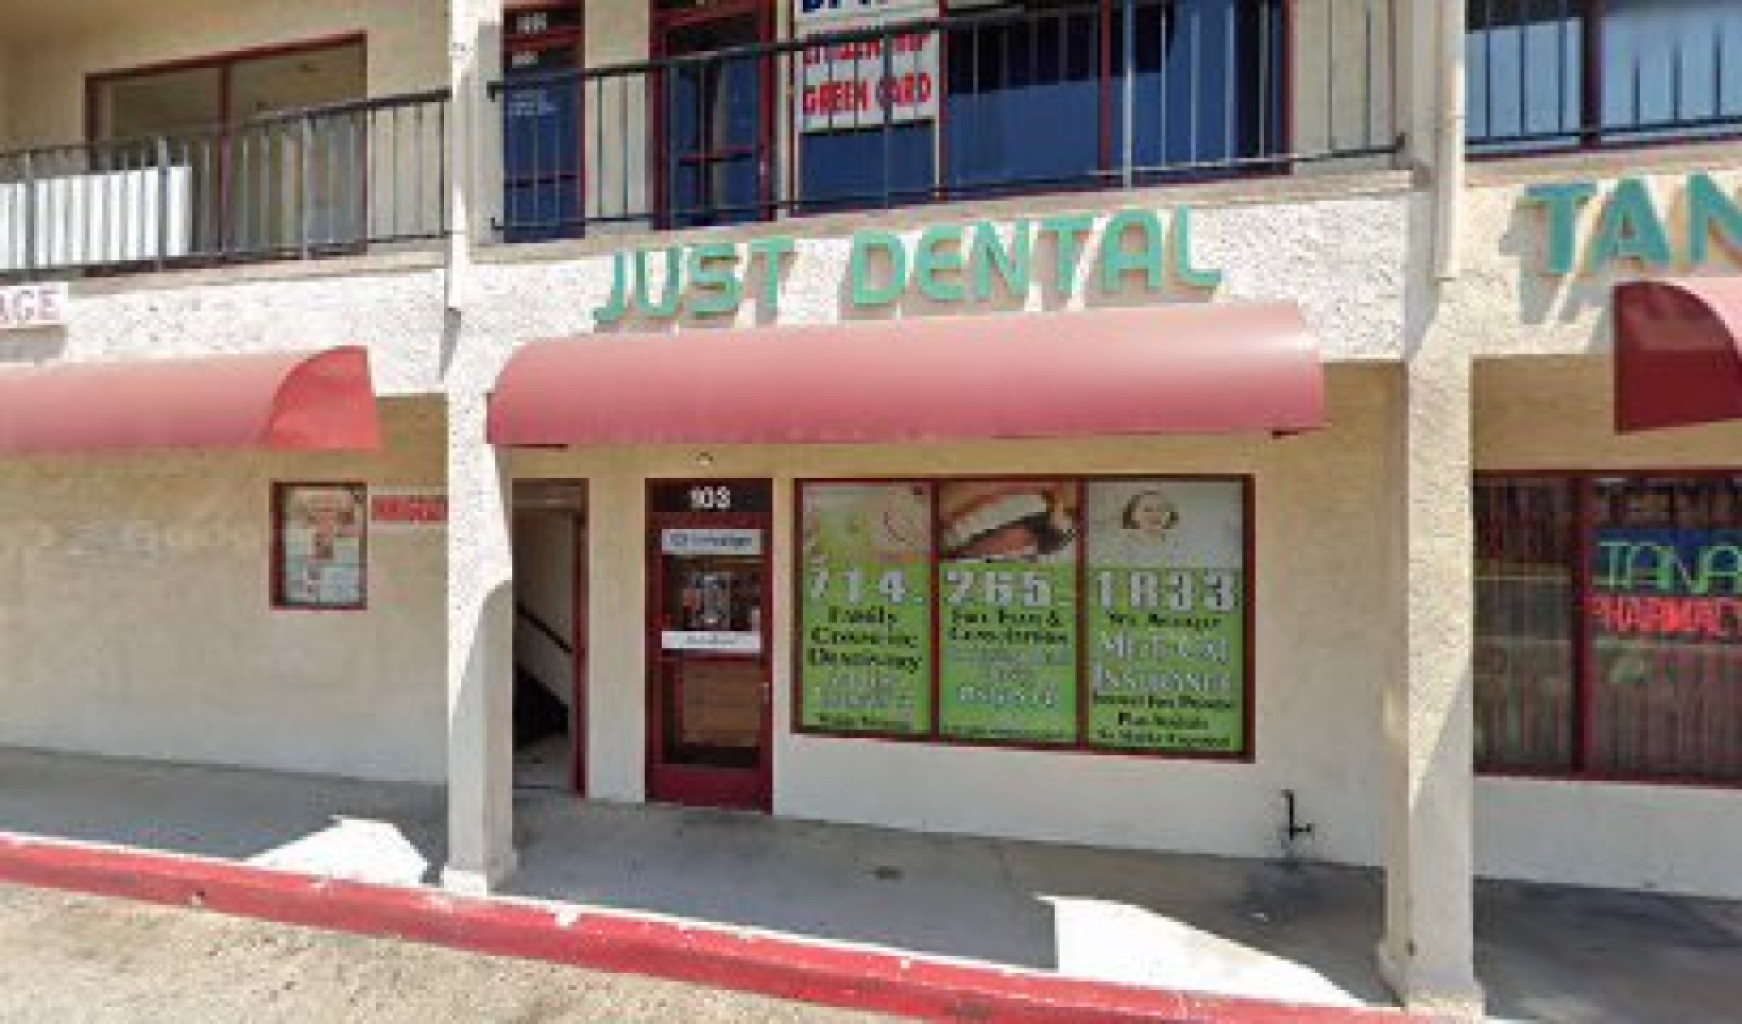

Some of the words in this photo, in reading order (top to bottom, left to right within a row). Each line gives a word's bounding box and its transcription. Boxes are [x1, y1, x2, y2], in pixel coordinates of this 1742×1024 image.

[802, 80, 871, 115] GREEN
[594, 236, 795, 324] JUST
[849, 205, 1222, 304] DENTAL
